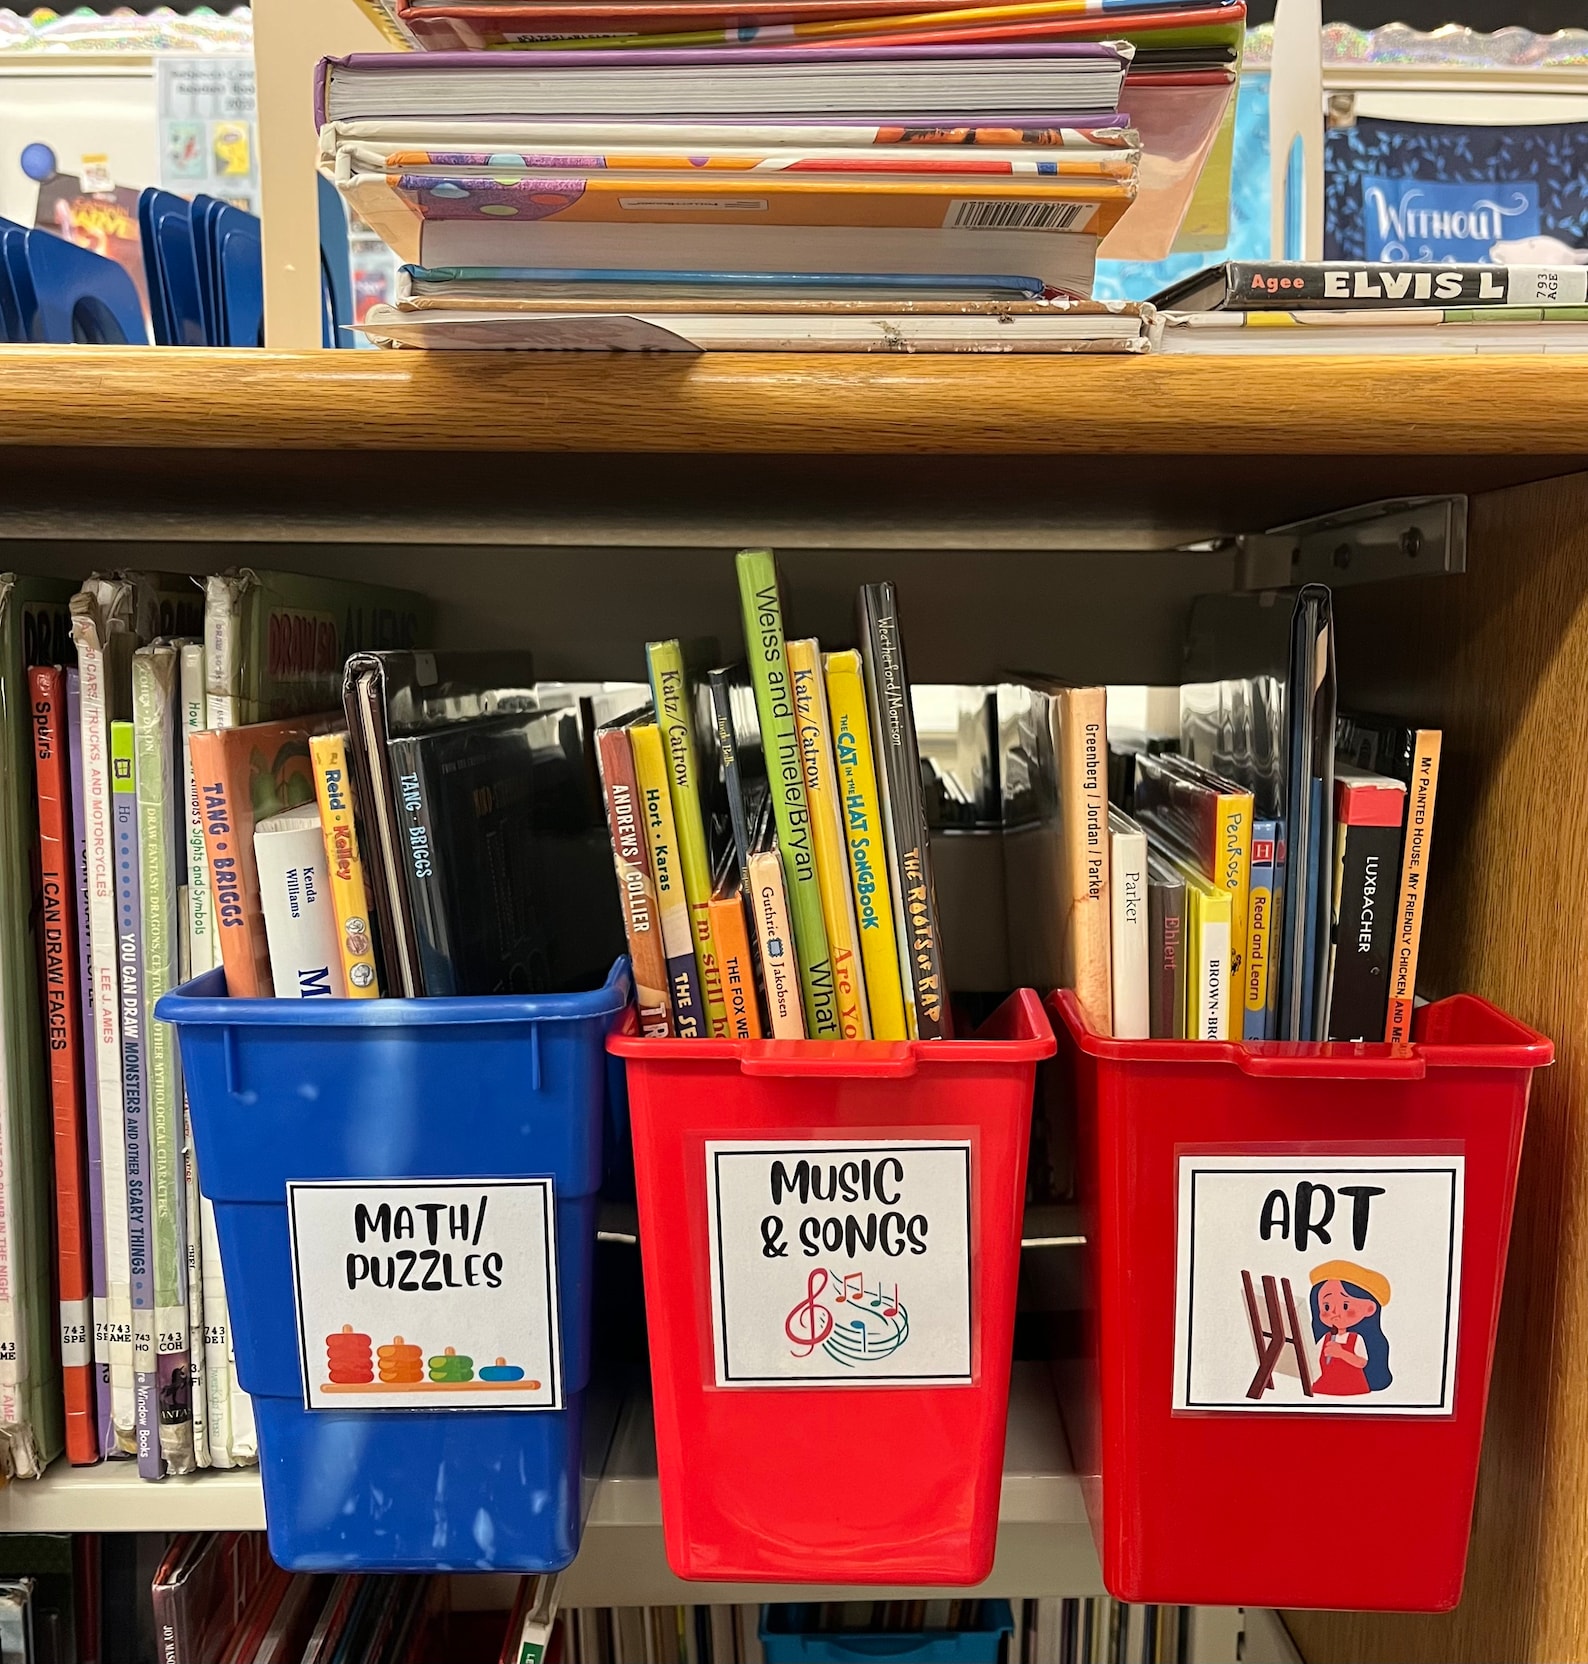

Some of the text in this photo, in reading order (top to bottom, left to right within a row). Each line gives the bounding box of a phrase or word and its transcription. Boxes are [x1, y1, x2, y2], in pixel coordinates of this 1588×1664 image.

[1365, 185, 1529, 241] WITHOUT
[1250, 273, 1305, 293] Agee
[1323, 271, 1463, 299] ELVIS
[1537, 273, 1548, 298] 793
[1547, 273, 1558, 300] AGE
[34, 701, 53, 759] Speirs
[188, 702, 201, 727] How
[839, 714, 849, 732] THE
[837, 732, 858, 766] CAT
[1083, 723, 1100, 790] Greenberg
[91, 769, 103, 797] AND
[845, 766, 853, 777] IN
[847, 779, 857, 795] THE
[647, 789, 663, 828] Hort
[755, 584, 838, 1035] Weiss and Thiele/Bryan What
[846, 793, 869, 832] HAT
[878, 616, 941, 1022] Weatherford/Morrison THE ROOTS OF RAP
[1414, 778, 1430, 825] PAINTED
[146, 807, 158, 839] DRAW
[325, 769, 353, 881] Reid Kelley
[400, 771, 432, 878] TANG BRIGGS
[661, 669, 690, 789] Katz/Catrow
[702, 953, 725, 1005] still
[1087, 803, 1101, 845] Jordan
[93, 800, 107, 898] MOTORCYCLES
[191, 828, 205, 861] Sights
[202, 782, 245, 928] TANG BRIGGS
[611, 784, 639, 857] ANDREWS
[626, 873, 651, 933] COLLIER
[793, 669, 859, 1039] Katz/Catrow Are Yo
[1407, 828, 1425, 870] HOUSE,
[148, 843, 160, 894] FANTASY:
[193, 865, 206, 886] and
[303, 866, 318, 904] Kenda
[654, 844, 672, 892] Karas
[1088, 859, 1103, 901] Parker
[44, 882, 61, 921] CAN
[193, 889, 207, 934] Symbols
[286, 868, 301, 919] Williams
[1126, 871, 1142, 924] Parker
[1358, 856, 1379, 953] LUXBACHER
[1402, 894, 1418, 945] FRIENDLY
[46, 930, 64, 984] DRAW
[762, 886, 789, 1018] Guthrie Jakobsen
[1164, 915, 1180, 970] Ehlert
[1249, 896, 1267, 1001] Read and Learn
[100, 967, 112, 991] LEE
[298, 966, 332, 998] M
[673, 972, 692, 1009] THE
[727, 956, 741, 984] THE
[49, 990, 67, 1050] FACES
[731, 987, 746, 1015] FOX
[102, 1008, 113, 1044] AMES
[118, 805, 146, 1275] Ho YOU CAN DRAW MONSTERS AND OTHER SCARY THINGS
[153, 1022, 164, 1059] OTHER
[154, 1062, 166, 1149] MYTHOLOGICAL
[156, 1150, 168, 1218] CHARACTERS
[769, 1157, 904, 1206] MUSIC
[354, 1195, 489, 1247] MATH/
[761, 1211, 930, 1259] & SONGS
[1259, 1180, 1386, 1252] ART
[345, 1251, 503, 1292] PUZZLES
[63, 1325, 86, 1334] 743
[63, 1335, 87, 1344] SPE
[109, 1324, 131, 1333] 743
[109, 1334, 132, 1342] AME
[135, 1333, 150, 1342] 743
[135, 1344, 149, 1352] HO
[159, 1332, 182, 1341] 743
[159, 1342, 183, 1351] COH
[205, 1326, 225, 1335] 743
[137, 1386, 150, 1426] Window
[140, 1429, 150, 1458] Books
[163, 1624, 174, 1641] JOY
